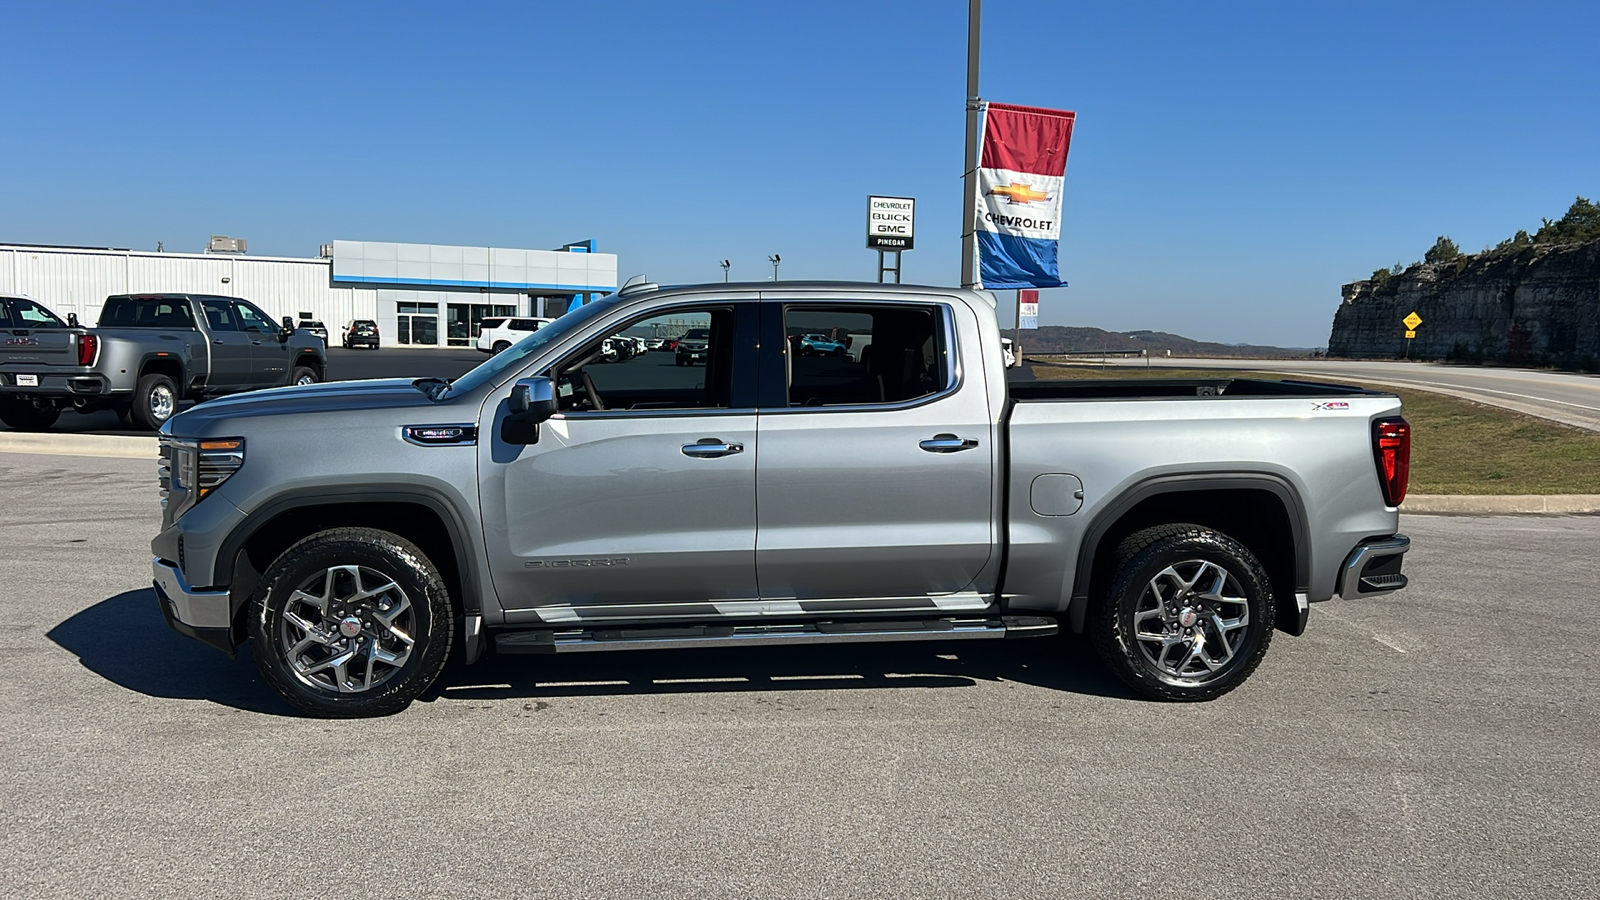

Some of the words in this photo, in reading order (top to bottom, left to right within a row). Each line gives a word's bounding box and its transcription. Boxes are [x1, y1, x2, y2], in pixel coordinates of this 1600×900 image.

[873, 201, 911, 210] CHEVROLET
[872, 212, 911, 222] BUICK
[985, 212, 1052, 231] CHEVROLET
[877, 224, 906, 233] GMC
[877, 238, 905, 246] PINEGAR
[524, 556, 631, 569] SIERRA
